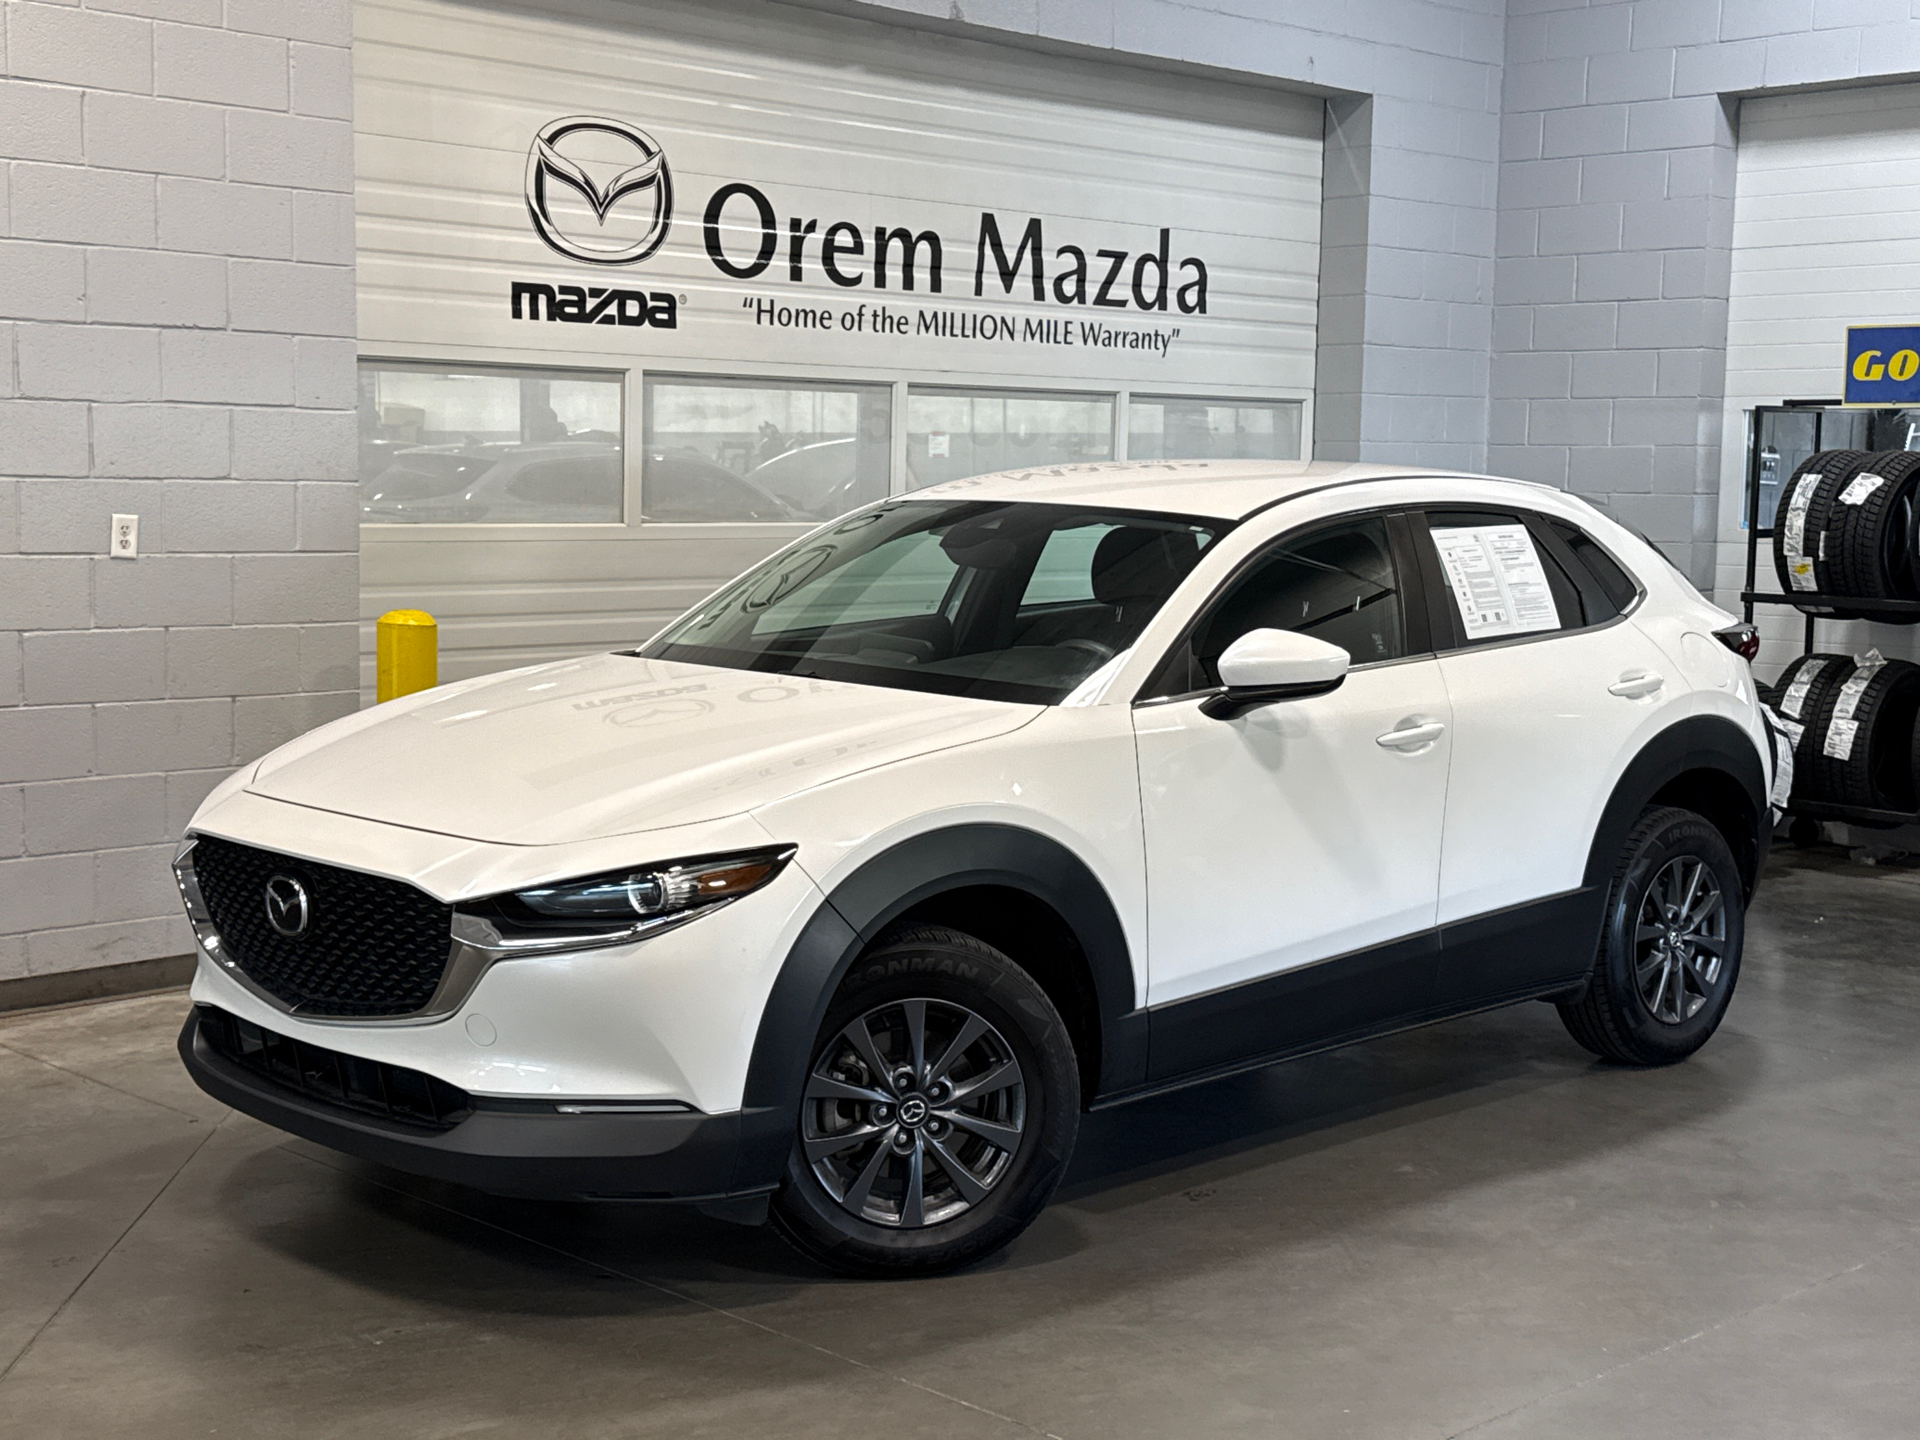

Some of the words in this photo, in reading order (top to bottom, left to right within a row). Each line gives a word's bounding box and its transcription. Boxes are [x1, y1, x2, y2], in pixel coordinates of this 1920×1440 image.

[703, 183, 942, 293] Orem
[974, 212, 1207, 314] Mazda
[511, 281, 677, 329] mazda
[743, 297, 832, 329] “Home
[841, 304, 866, 332] of
[872, 306, 909, 335] the
[916, 310, 1016, 341] MILLION
[1023, 318, 1073, 345] MILE
[1080, 322, 1180, 358] Warranty”
[1852, 349, 1920, 381] GO
[841, 957, 980, 991] RONMAN
